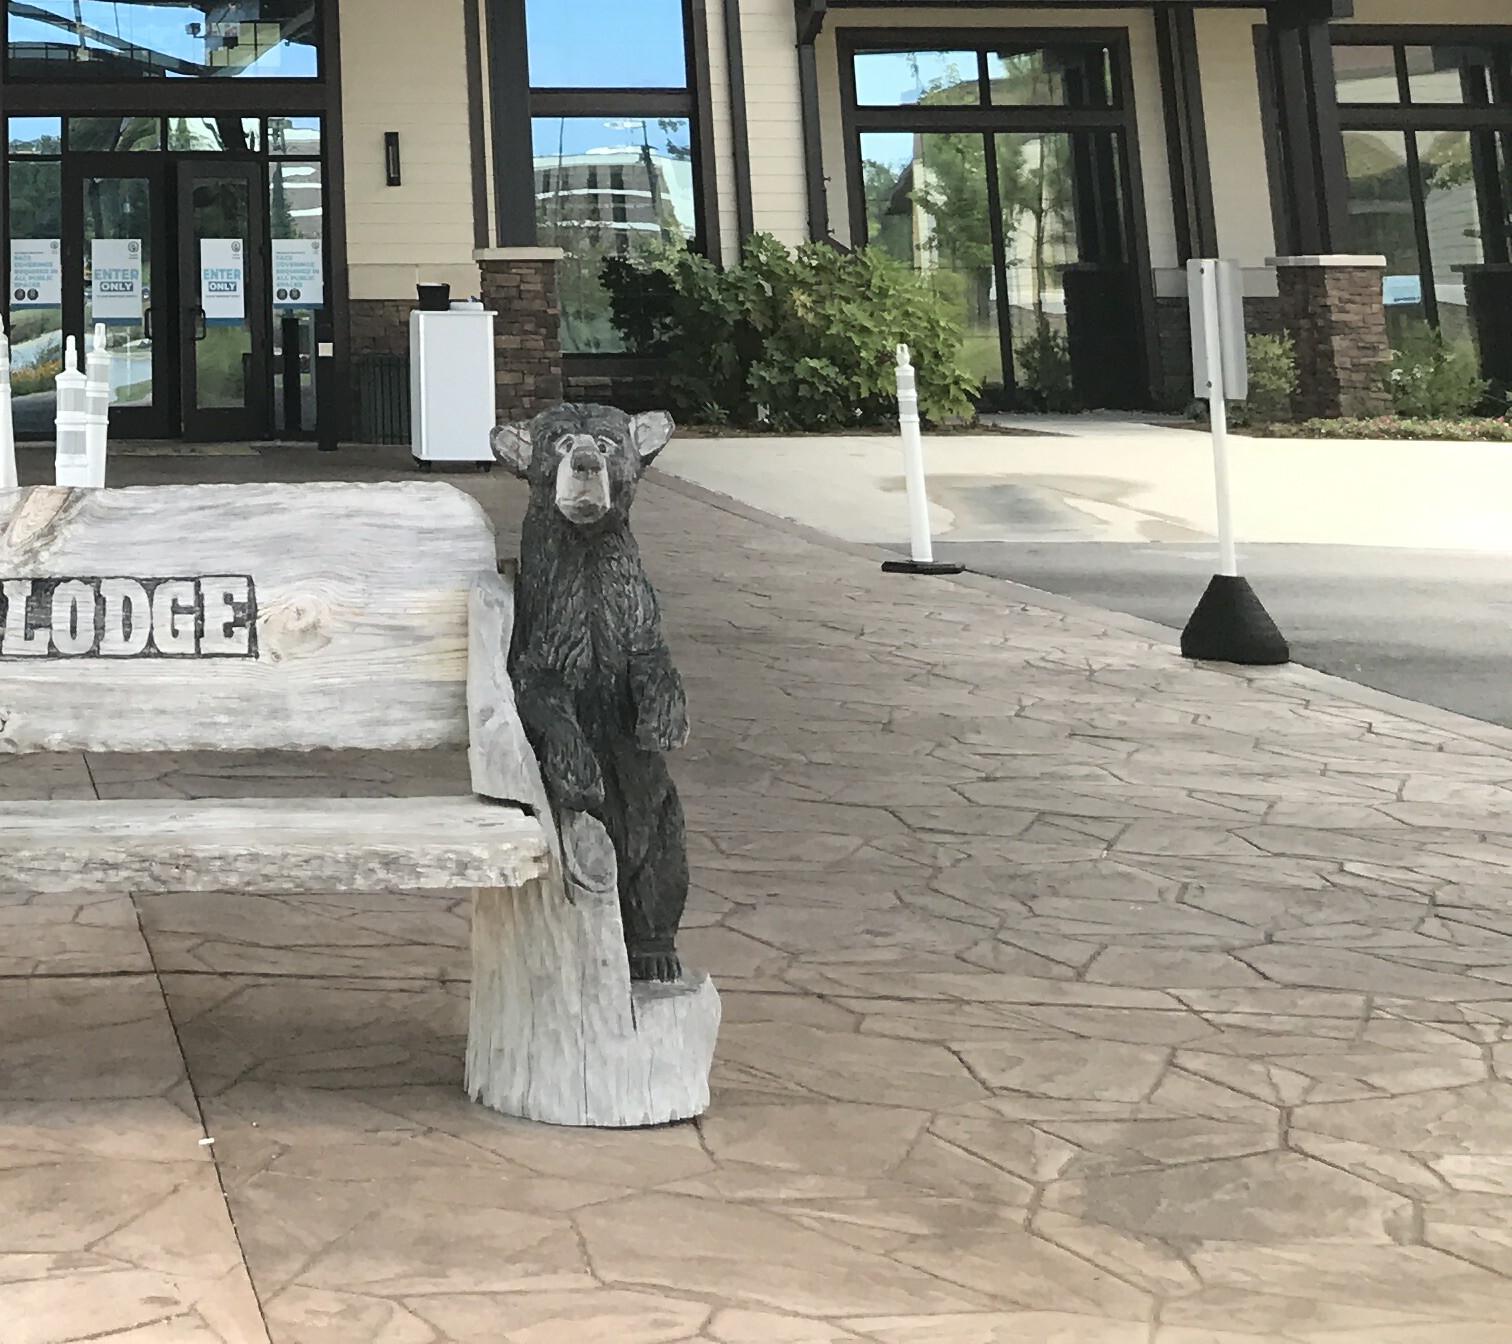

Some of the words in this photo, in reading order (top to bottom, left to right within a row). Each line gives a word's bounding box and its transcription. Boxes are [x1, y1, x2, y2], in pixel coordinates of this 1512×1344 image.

[94, 268, 140, 281] ENTER
[203, 268, 242, 281] ENTER
[100, 281, 134, 292] ONLY
[208, 281, 237, 292] ONLY
